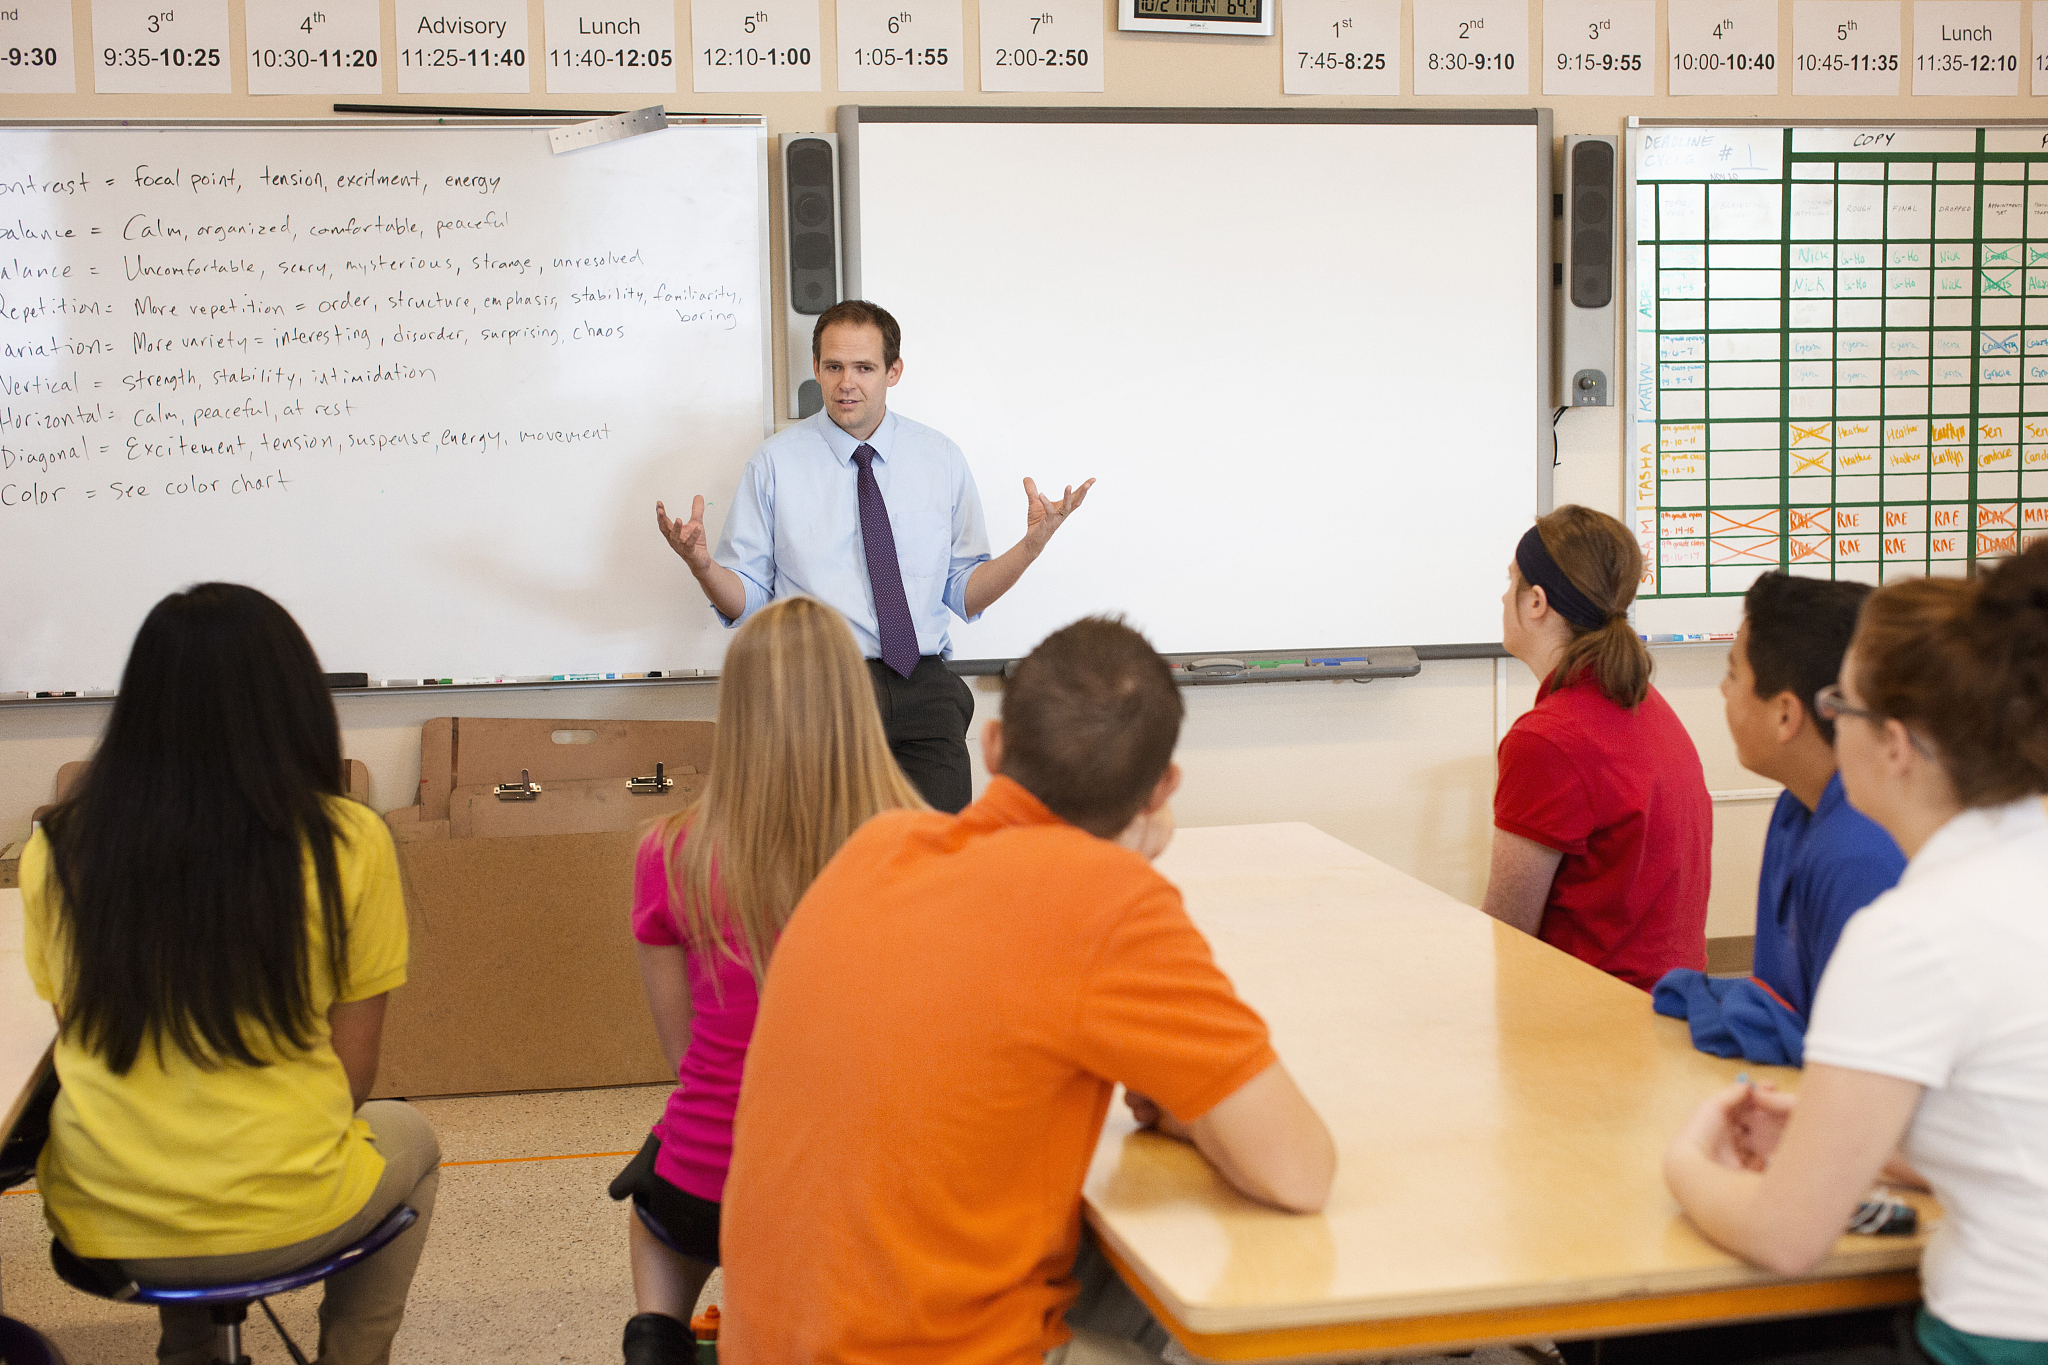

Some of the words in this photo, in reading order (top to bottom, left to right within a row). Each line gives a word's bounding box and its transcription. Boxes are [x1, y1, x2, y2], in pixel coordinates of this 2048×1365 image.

[148, 10, 173, 33] 3rd
[300, 12, 325, 34] 4th
[418, 16, 506, 38] Advisory
[580, 17, 640, 34] Lunch
[745, 11, 767, 33] 5th
[888, 11, 911, 33] 6th
[1031, 13, 1053, 34] 7th
[1333, 18, 1352, 38] 1st
[1459, 18, 1483, 39] 2nd
[1589, 19, 1610, 39] 3rd
[1713, 19, 1733, 39] 4th
[1838, 20, 1857, 40] 5th
[1942, 25, 1991, 41] Lunch
[104, 48, 220, 66] 9:35-10:25
[253, 50, 377, 67] 10:30-11:20
[402, 49, 525, 66] 11:25-11:40
[551, 49, 672, 67] 11:40-12:05
[704, 48, 810, 65] 12:10-1:00
[855, 48, 948, 65] 1:05-1:55
[996, 49, 1088, 66] 2:00-2:50
[1298, 52, 1385, 70] 7:45-8:25
[1429, 53, 1514, 70] 8:30-9:10
[1558, 53, 1641, 71] 9:15-9:55
[1674, 54, 1774, 70] 10:00-10:40
[1798, 54, 1898, 71] 10:45-11:35
[1918, 55, 2017, 71] 11:35-12:10
[1645, 135, 1715, 149] DEADLINE
[1853, 131, 1896, 147] COPY
[1719, 144, 1733, 161] #
[191, 168, 241, 194] point,
[260, 165, 327, 192] tension,
[445, 176, 500, 194] energy
[1846, 204, 1872, 213] ROUGH
[1891, 204, 1918, 213] FINAL
[1938, 204, 1973, 213] DROPPED
[123, 214, 187, 241] Calm,
[197, 214, 296, 242] organized,
[310, 215, 423, 239] comfortable,
[437, 211, 508, 239] peaceful
[1798, 247, 1829, 264] Nick
[124, 254, 264, 281] Uncomfortable,
[278, 262, 332, 280] scary,
[346, 255, 460, 276] mysterious,
[472, 253, 542, 275] strange,
[553, 249, 643, 268] unresolved
[1792, 278, 1826, 293] Nick
[134, 296, 178, 316] More
[190, 294, 284, 319] repetition
[318, 291, 377, 312] order,
[388, 290, 476, 314] structure,
[571, 286, 646, 305] stability,
[676, 309, 736, 330] boring
[133, 332, 172, 354] More
[182, 331, 247, 354] variety
[394, 324, 467, 345] disorder,
[481, 325, 564, 345] surprising,
[573, 320, 624, 339] chaos
[213, 367, 301, 390] stability,
[312, 363, 436, 385] intimidation
[194, 398, 277, 427] peaceful,
[283, 399, 303, 415] at
[315, 400, 353, 416] rest
[1, 436, 89, 473] Diagonal
[126, 435, 252, 461] Excitement,
[261, 433, 341, 453] tension,
[349, 432, 438, 452] suspense,
[441, 429, 507, 453] energy,
[520, 423, 608, 443] movement
[1638, 443, 1655, 501] TASHA
[1, 482, 65, 506] Color
[166, 475, 219, 495] color
[232, 469, 290, 494] chart
[1837, 512, 1859, 528] RAE
[1886, 511, 1908, 527] RAE
[1934, 510, 1959, 527] RAE
[1840, 539, 1861, 556] RAE
[1885, 538, 1907, 555] RAE
[1933, 538, 1956, 554] RAE
